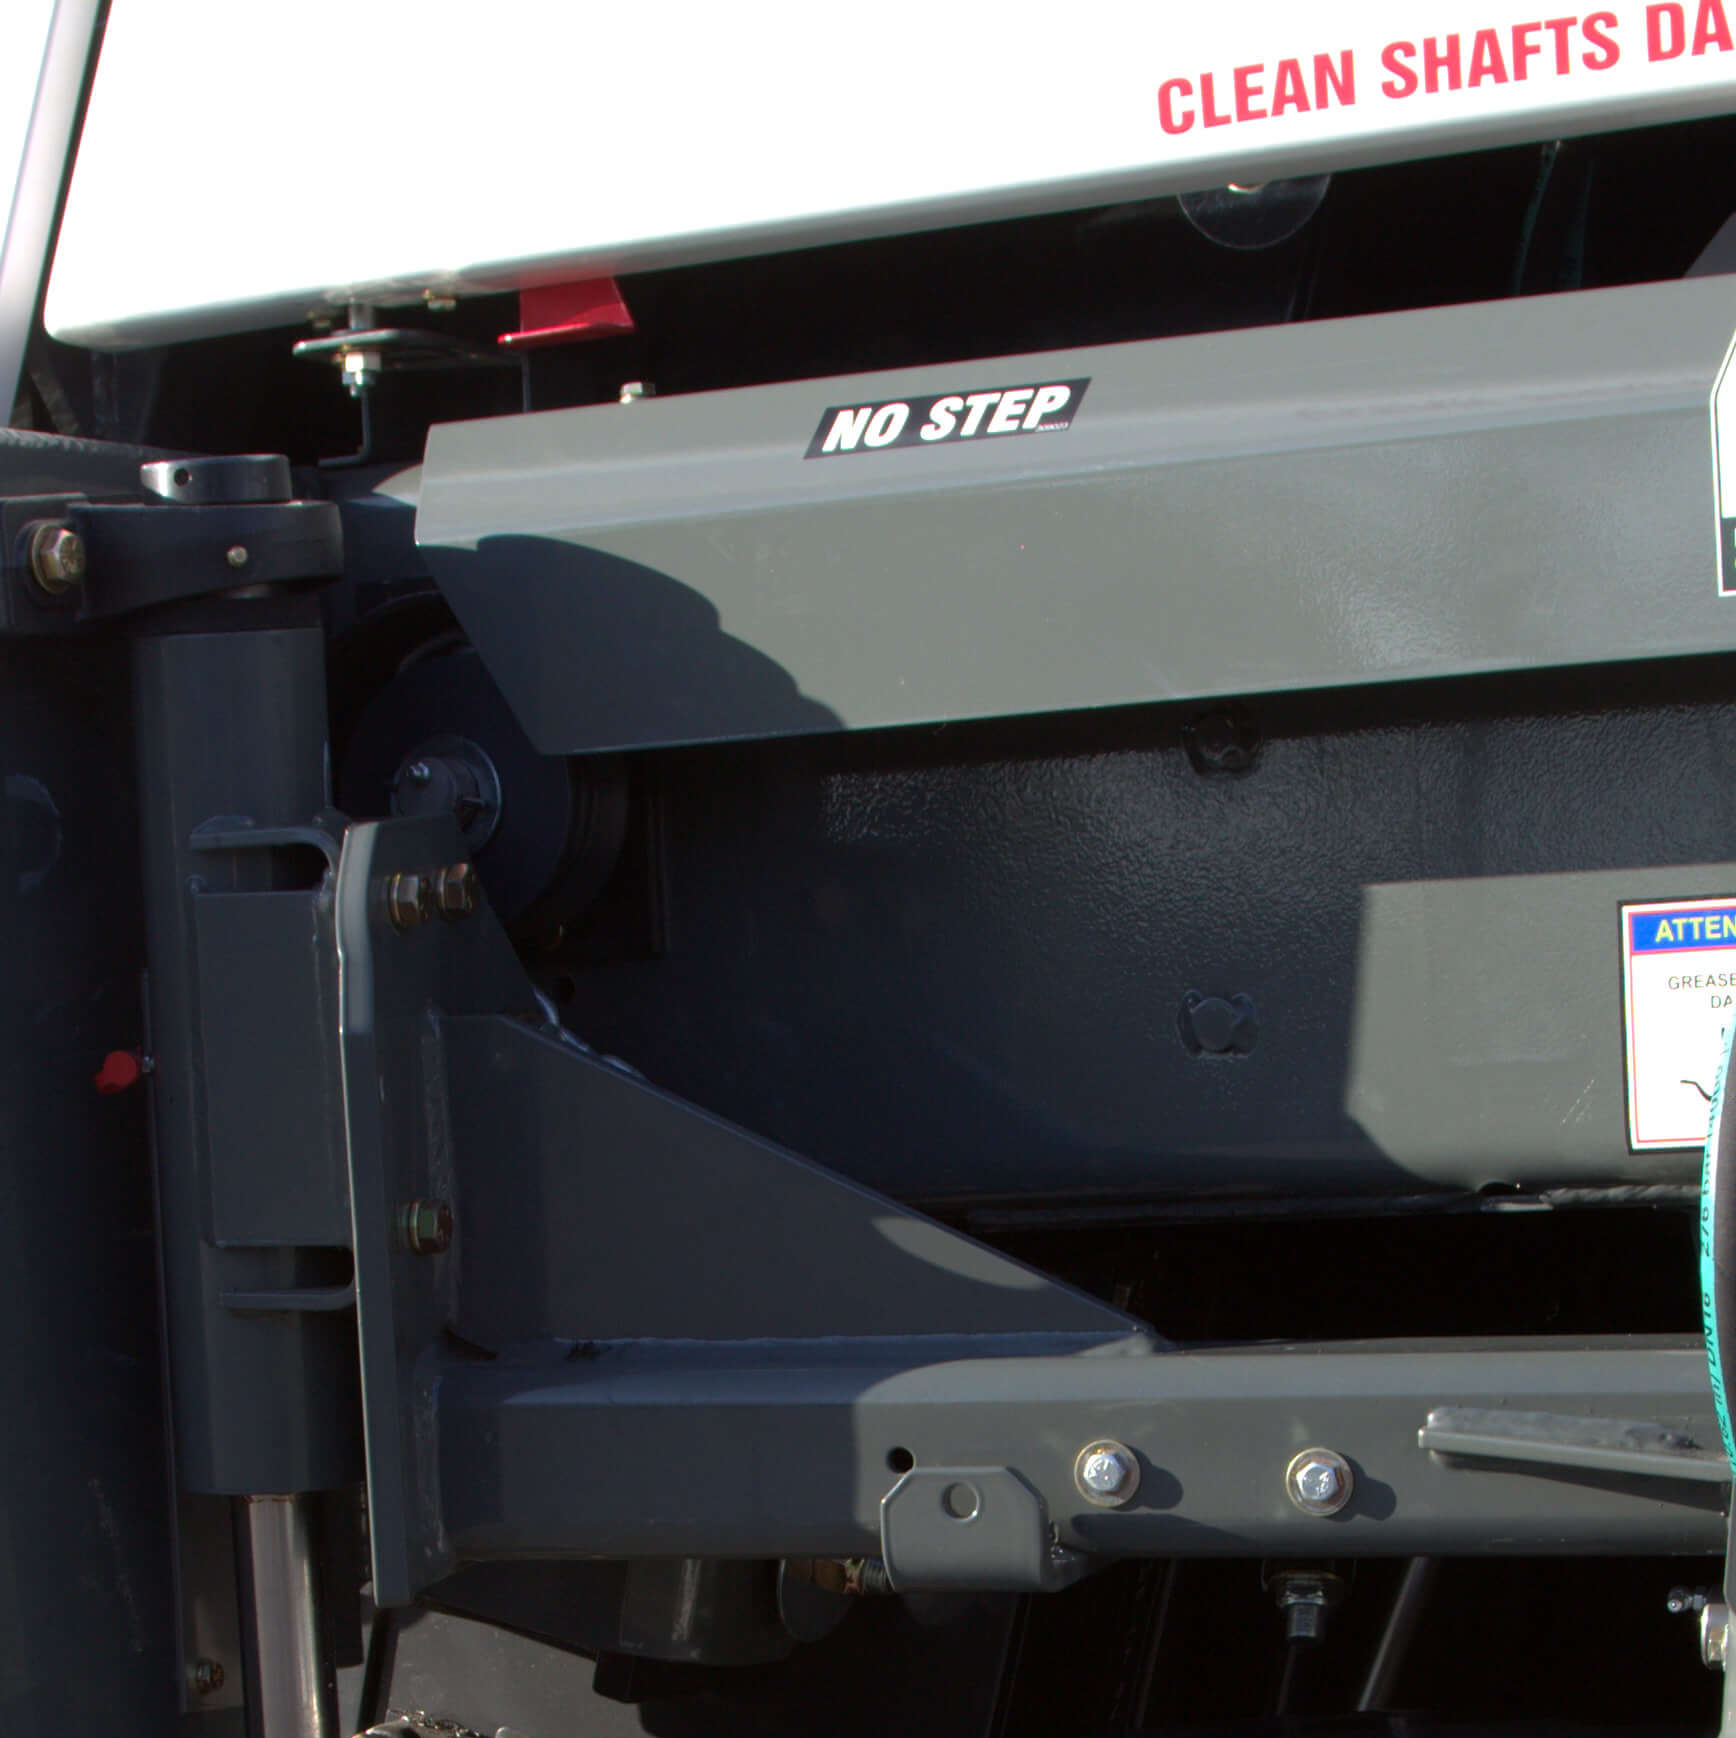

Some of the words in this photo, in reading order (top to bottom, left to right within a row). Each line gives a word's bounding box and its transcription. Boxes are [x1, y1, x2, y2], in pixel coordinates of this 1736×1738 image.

[1157, 50, 1356, 135] CLEAN
[1381, 11, 1620, 99] SHAFTS
[821, 402, 910, 453] NO
[920, 384, 1071, 441] STEP
